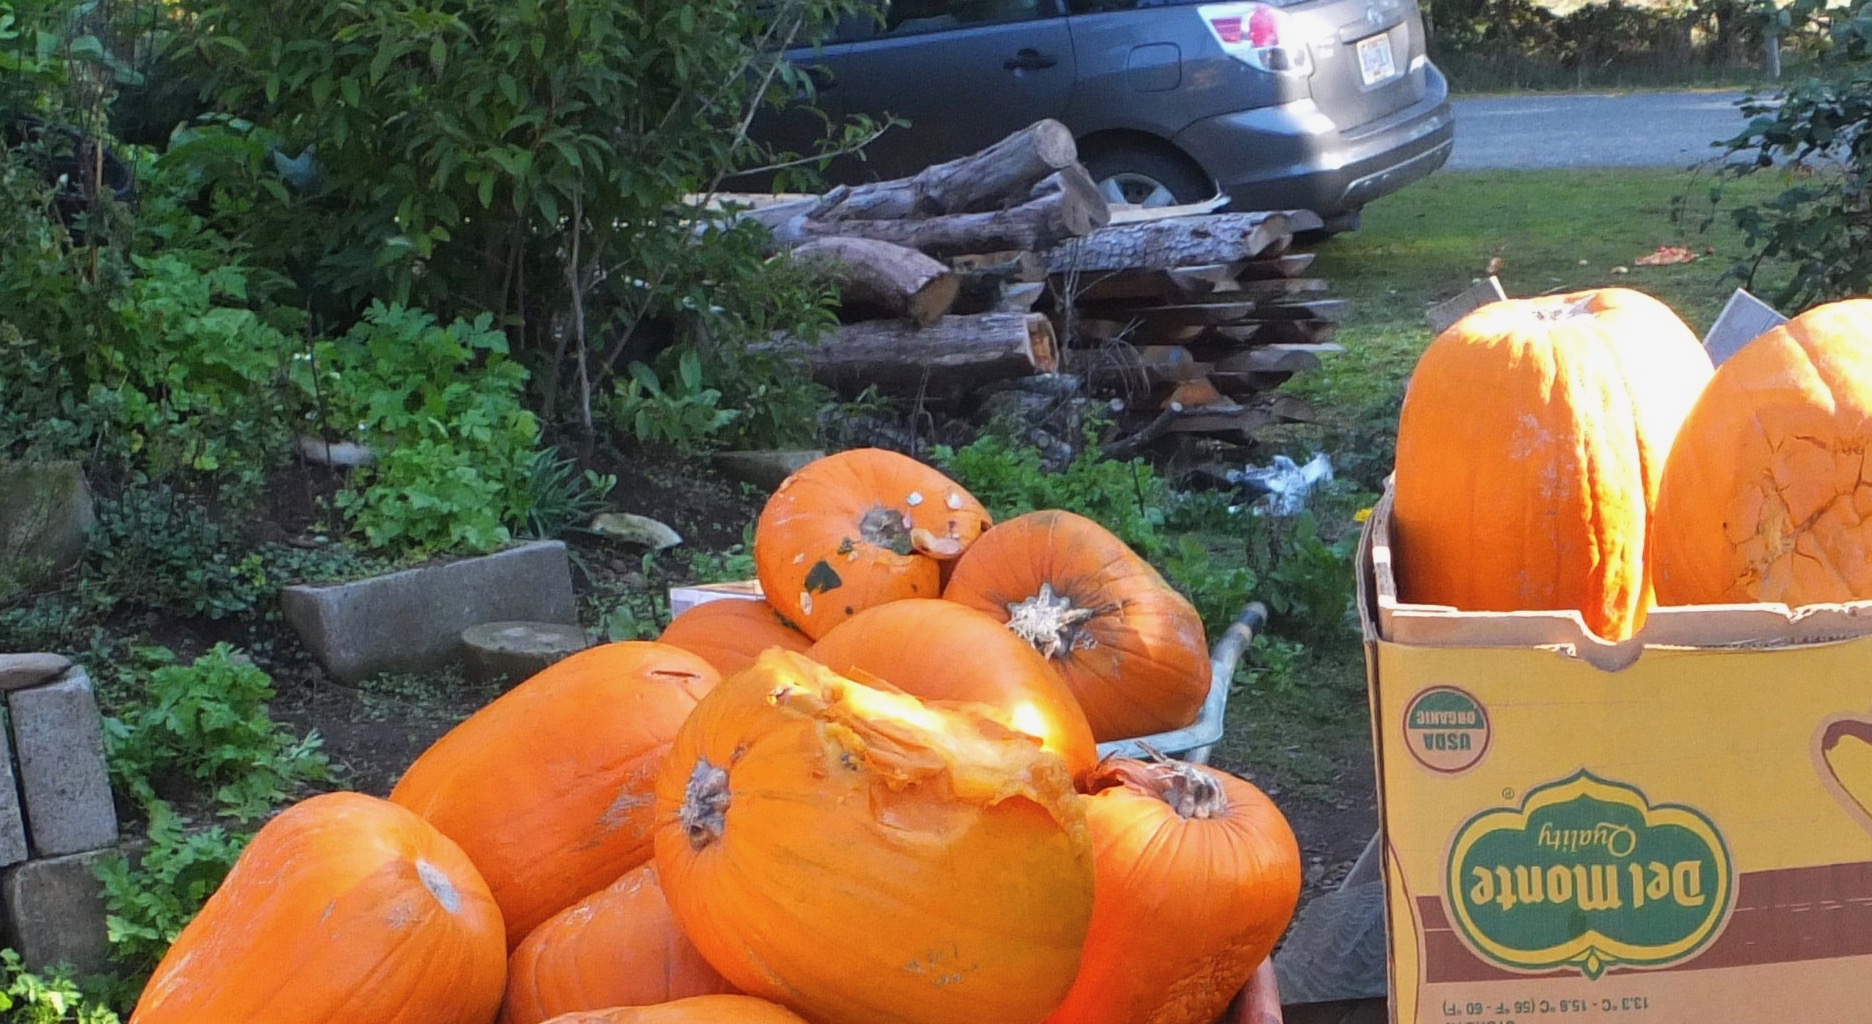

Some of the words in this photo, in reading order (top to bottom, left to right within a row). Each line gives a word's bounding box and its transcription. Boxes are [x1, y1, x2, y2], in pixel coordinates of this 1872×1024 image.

[1416, 710, 1475, 725] ORGANIC
[1423, 733, 1471, 751] USDA
[1537, 822, 1636, 858] Quality
[1470, 863, 1622, 911] Monte
[1628, 859, 1706, 909] Del
